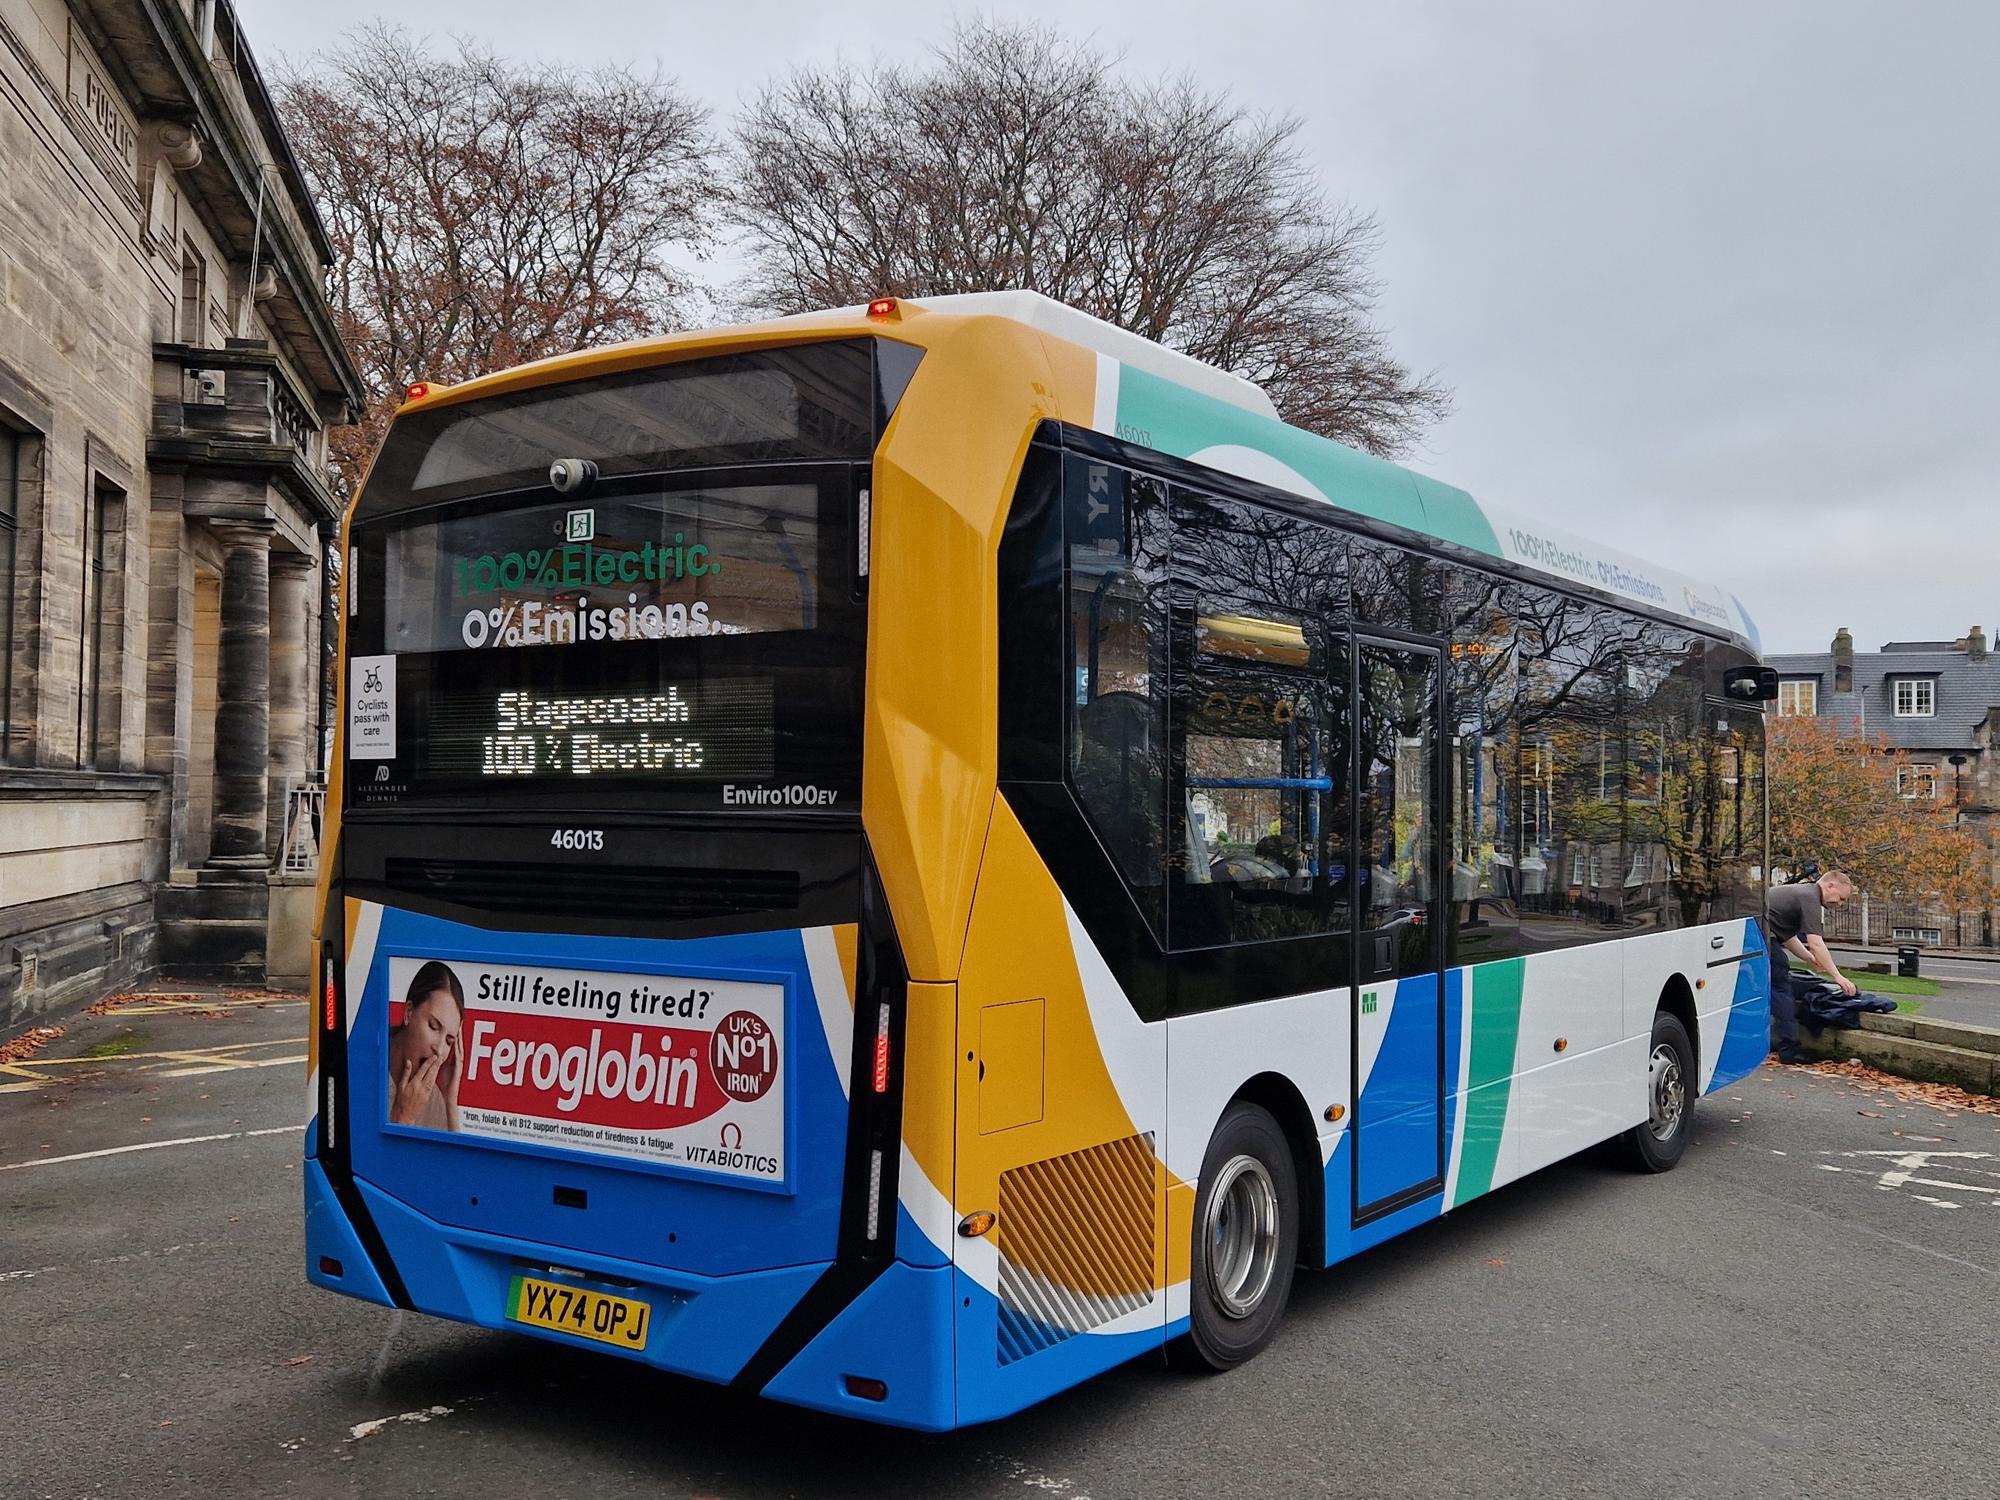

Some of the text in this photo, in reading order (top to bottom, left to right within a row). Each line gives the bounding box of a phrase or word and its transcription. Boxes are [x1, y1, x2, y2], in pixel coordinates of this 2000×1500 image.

[1115, 421, 1153, 449] 46013
[354, 711, 390, 725] pass with
[358, 699, 389, 712] Cyclists
[497, 686, 689, 731] Stagecoach
[363, 726, 380, 736] care
[482, 736, 536, 775] 100
[571, 733, 705, 775] Electric
[550, 829, 604, 851] 46013
[478, 973, 526, 1002] Still
[533, 977, 621, 1019] feeling
[482, 1113, 500, 1126] folate
[502, 1116, 507, 1126] &
[509, 1118, 517, 1127] vit
[519, 1119, 532, 1129] B12
[533, 1121, 559, 1134] support
[560, 1125, 594, 1138] reduction
[596, 1130, 603, 1139] of
[605, 1130, 638, 1145] tiredness
[640, 1135, 646, 1146] &
[648, 1137, 674, 1151] fatigue
[686, 1146, 777, 1174] VITABIOTICS
[527, 1284, 645, 1341] YX74 OPJ
